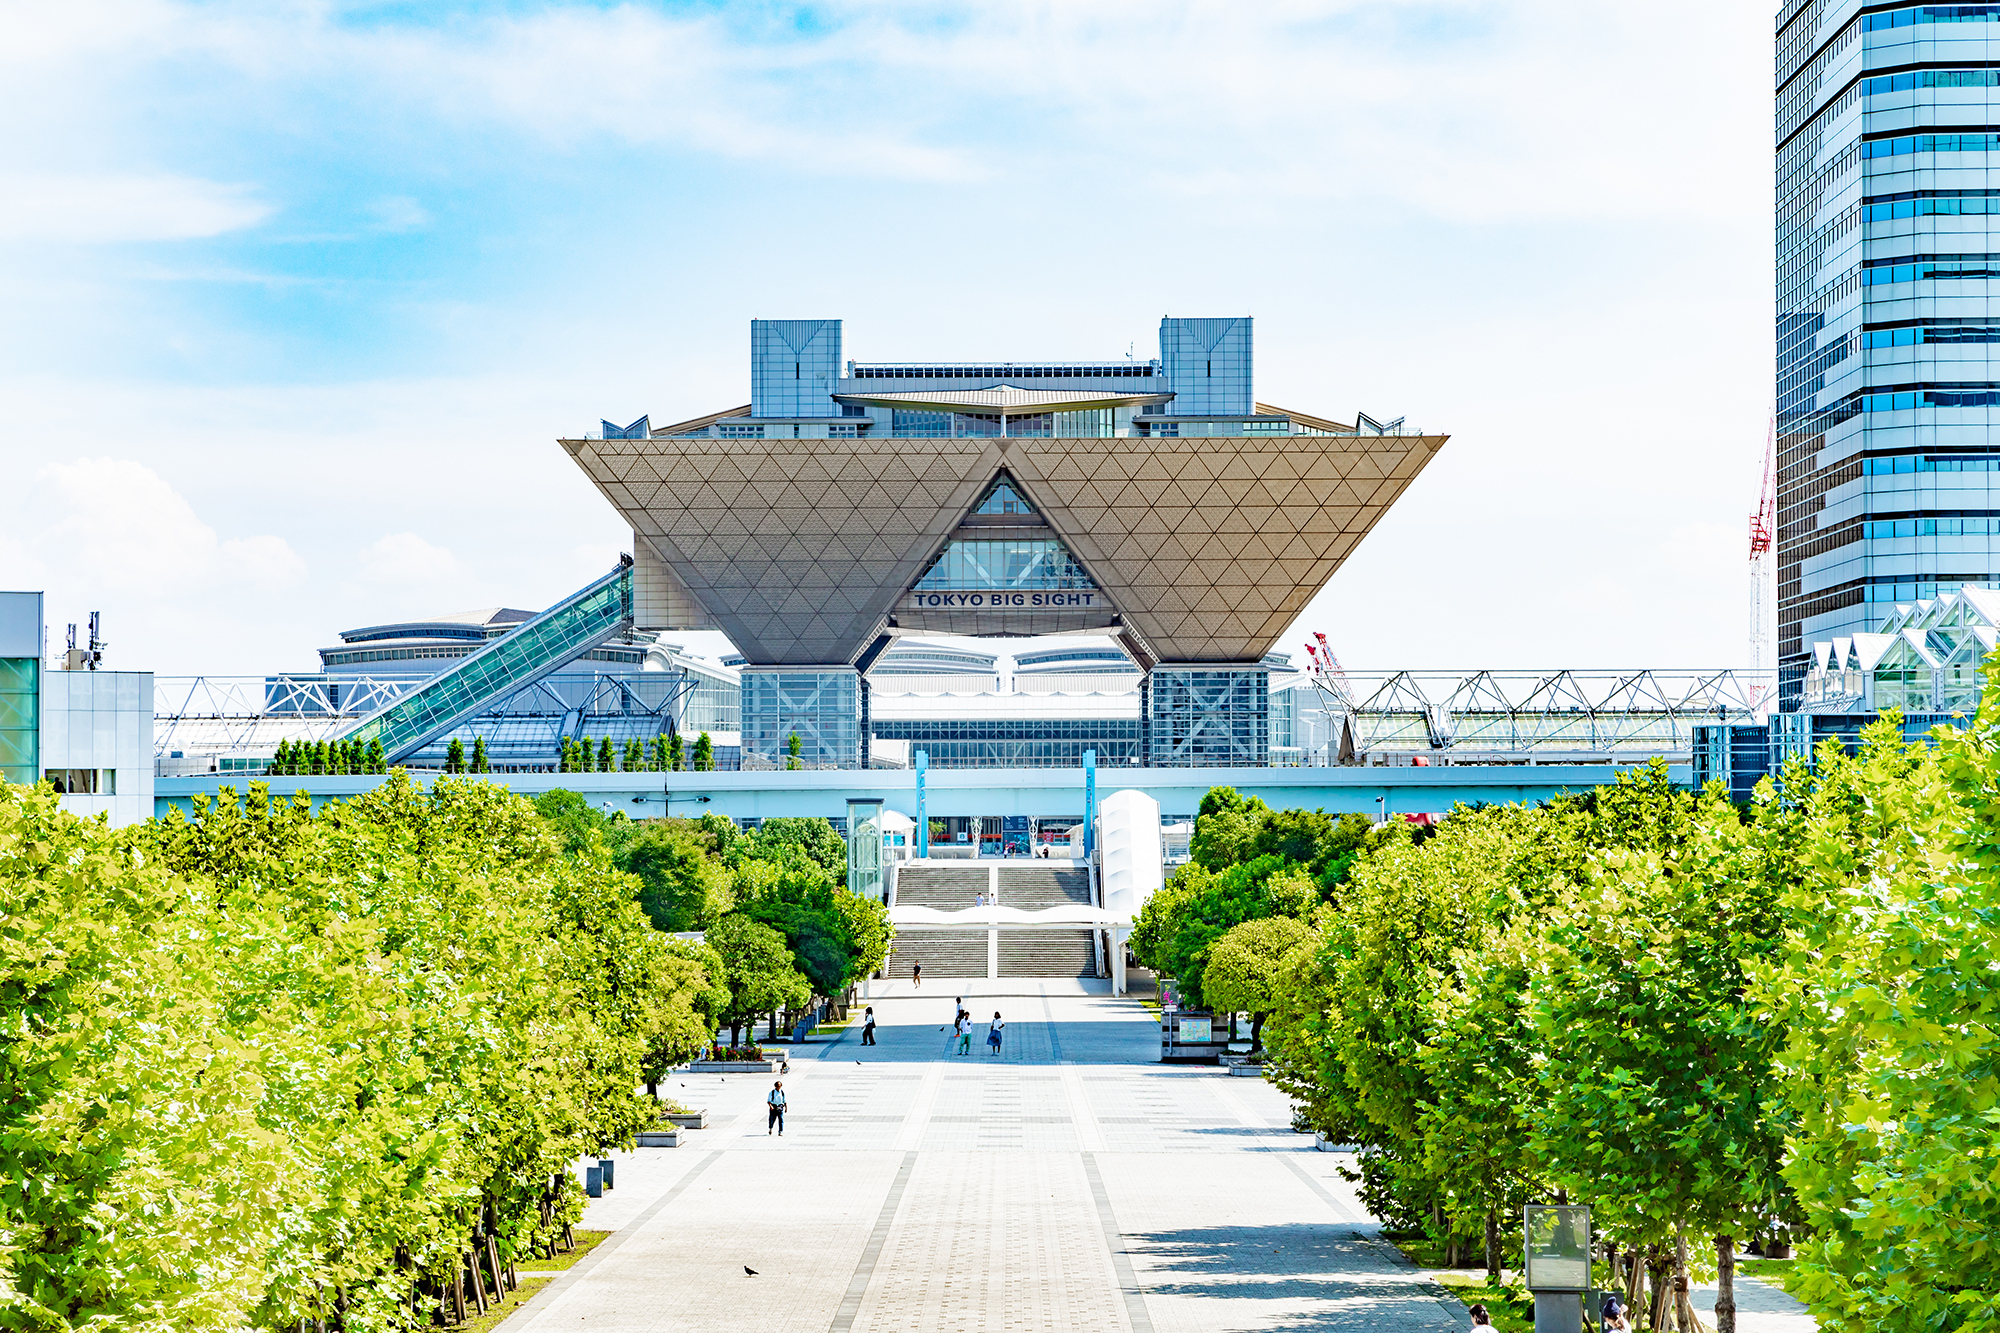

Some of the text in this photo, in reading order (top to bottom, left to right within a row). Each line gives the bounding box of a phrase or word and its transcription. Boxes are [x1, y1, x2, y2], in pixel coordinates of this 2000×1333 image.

[914, 593, 1095, 606] TOKYO BIG SIGHT
